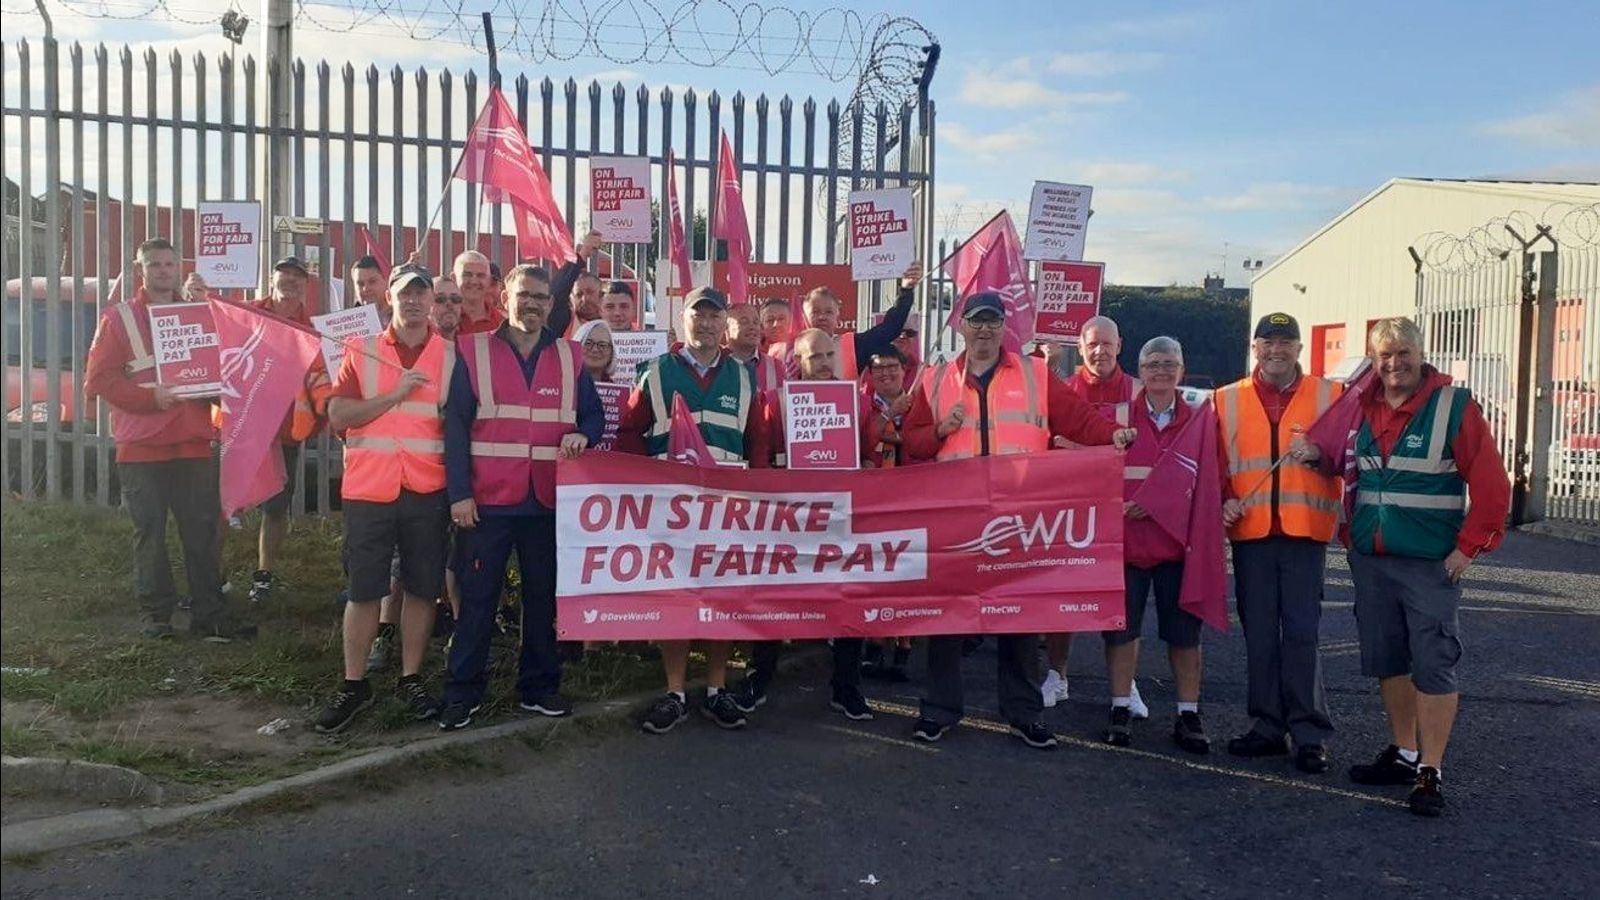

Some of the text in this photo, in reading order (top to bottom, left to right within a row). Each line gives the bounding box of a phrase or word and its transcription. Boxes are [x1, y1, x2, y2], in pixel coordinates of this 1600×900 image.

[595, 169, 611, 179] ON
[595, 179, 630, 189] STRIKE
[597, 189, 641, 199] FOR FAIR
[598, 200, 617, 210] PAY
[854, 203, 871, 214] ON
[203, 215, 219, 224] ON
[608, 218, 633, 227] CWU
[855, 211, 890, 225] STRIKE
[203, 225, 238, 234] STRIKE
[856, 221, 903, 236] FOR FAIR
[203, 234, 249, 244] FOR FAIR
[857, 235, 878, 246] PAY
[203, 246, 222, 255] PAY
[869, 253, 896, 262] CWU
[213, 263, 238, 272] CWU
[1045, 272, 1060, 280] ON
[1044, 283, 1079, 291] STRIKE
[1043, 292, 1090, 301] FOR FAIR
[1043, 303, 1063, 311] PAY
[157, 318, 174, 328] ON
[1052, 320, 1077, 330] CWU
[159, 326, 198, 339] STRIKE
[161, 336, 213, 350] FOR FAIR
[614, 338, 643, 346] MILLIONS
[164, 350, 185, 361] PAY
[178, 367, 208, 379] CWU
[792, 395, 810, 405] ON
[793, 405, 832, 417] STRIKE
[794, 416, 845, 428] FOR FAIR
[795, 430, 817, 440] PAY
[808, 449, 837, 460] CWU
[579, 494, 833, 532] ON STRIKE
[975, 506, 1096, 556] CWU
[581, 540, 911, 584] FOR FAIR PAY
[977, 556, 1096, 572] The communications union
[981, 606, 1021, 615] #TheCWU
[1059, 603, 1099, 613] CWU.ORG
[716, 611, 826, 620] The Communications Union
[895, 609, 942, 618] @CWUNews
